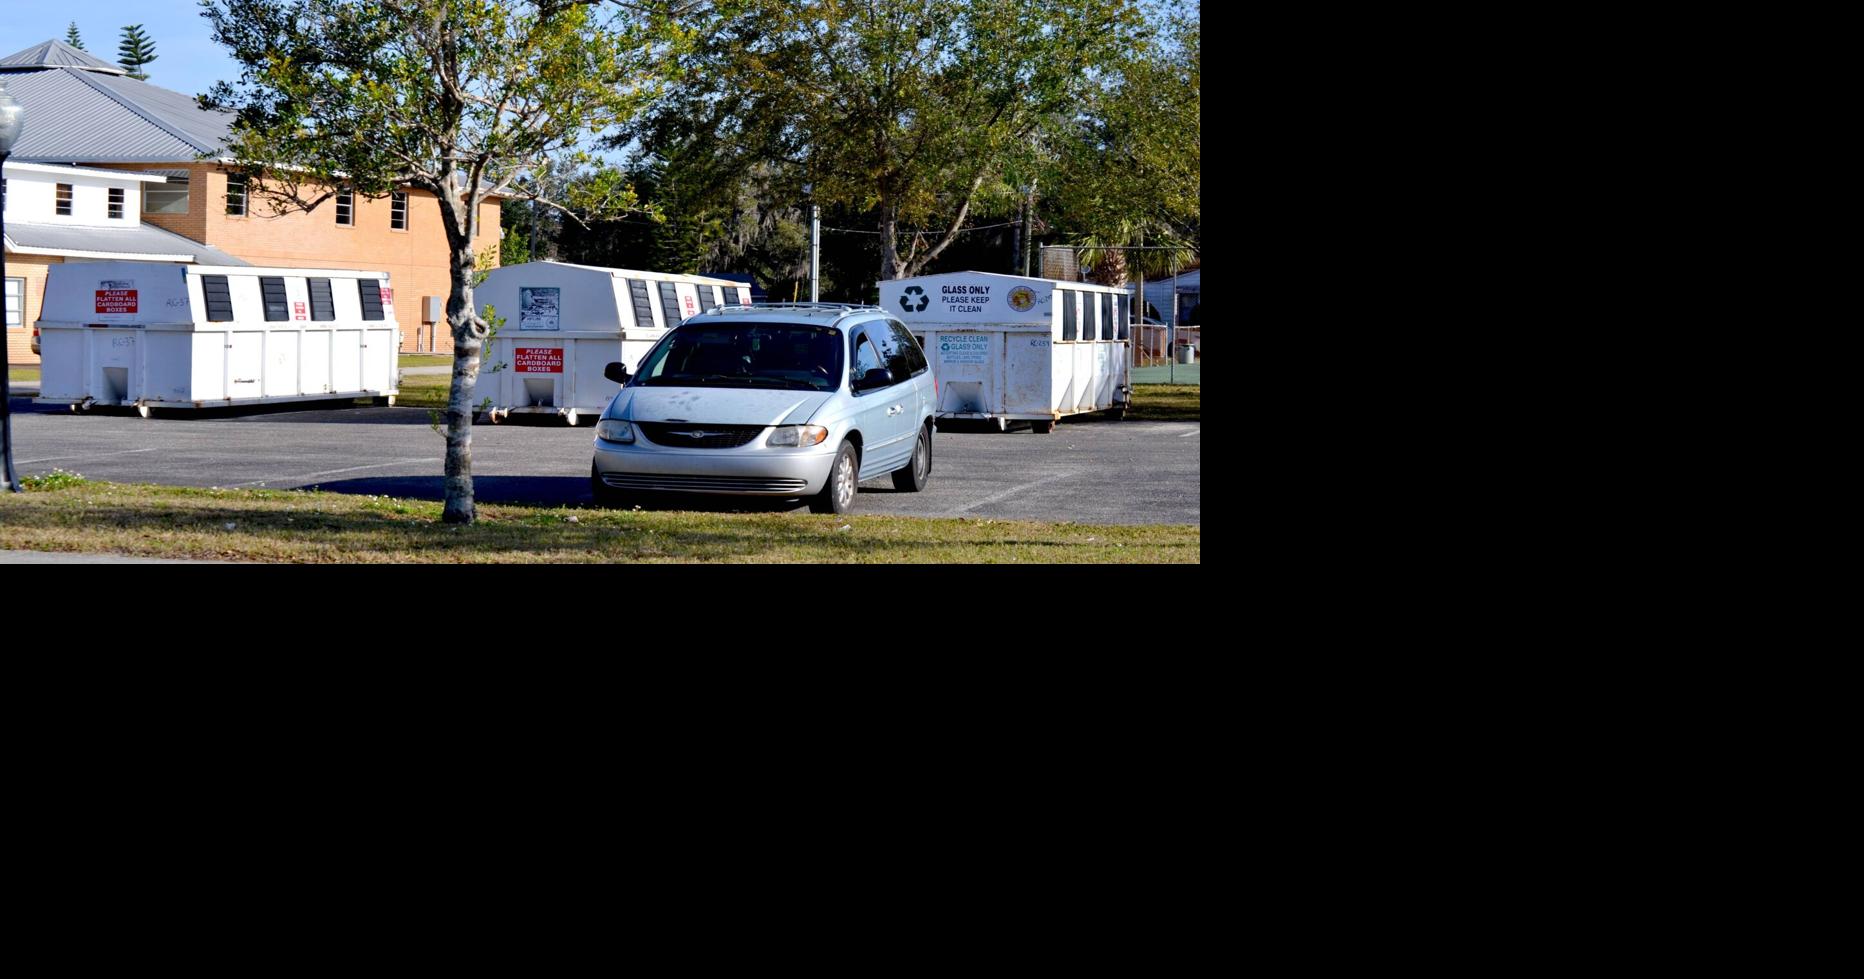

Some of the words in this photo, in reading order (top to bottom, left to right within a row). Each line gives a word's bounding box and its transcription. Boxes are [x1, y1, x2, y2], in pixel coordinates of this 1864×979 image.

[941, 285, 967, 294] GLASS
[969, 286, 990, 294] ONLY
[941, 295, 969, 304] PLEASE
[970, 296, 990, 304] KEEP
